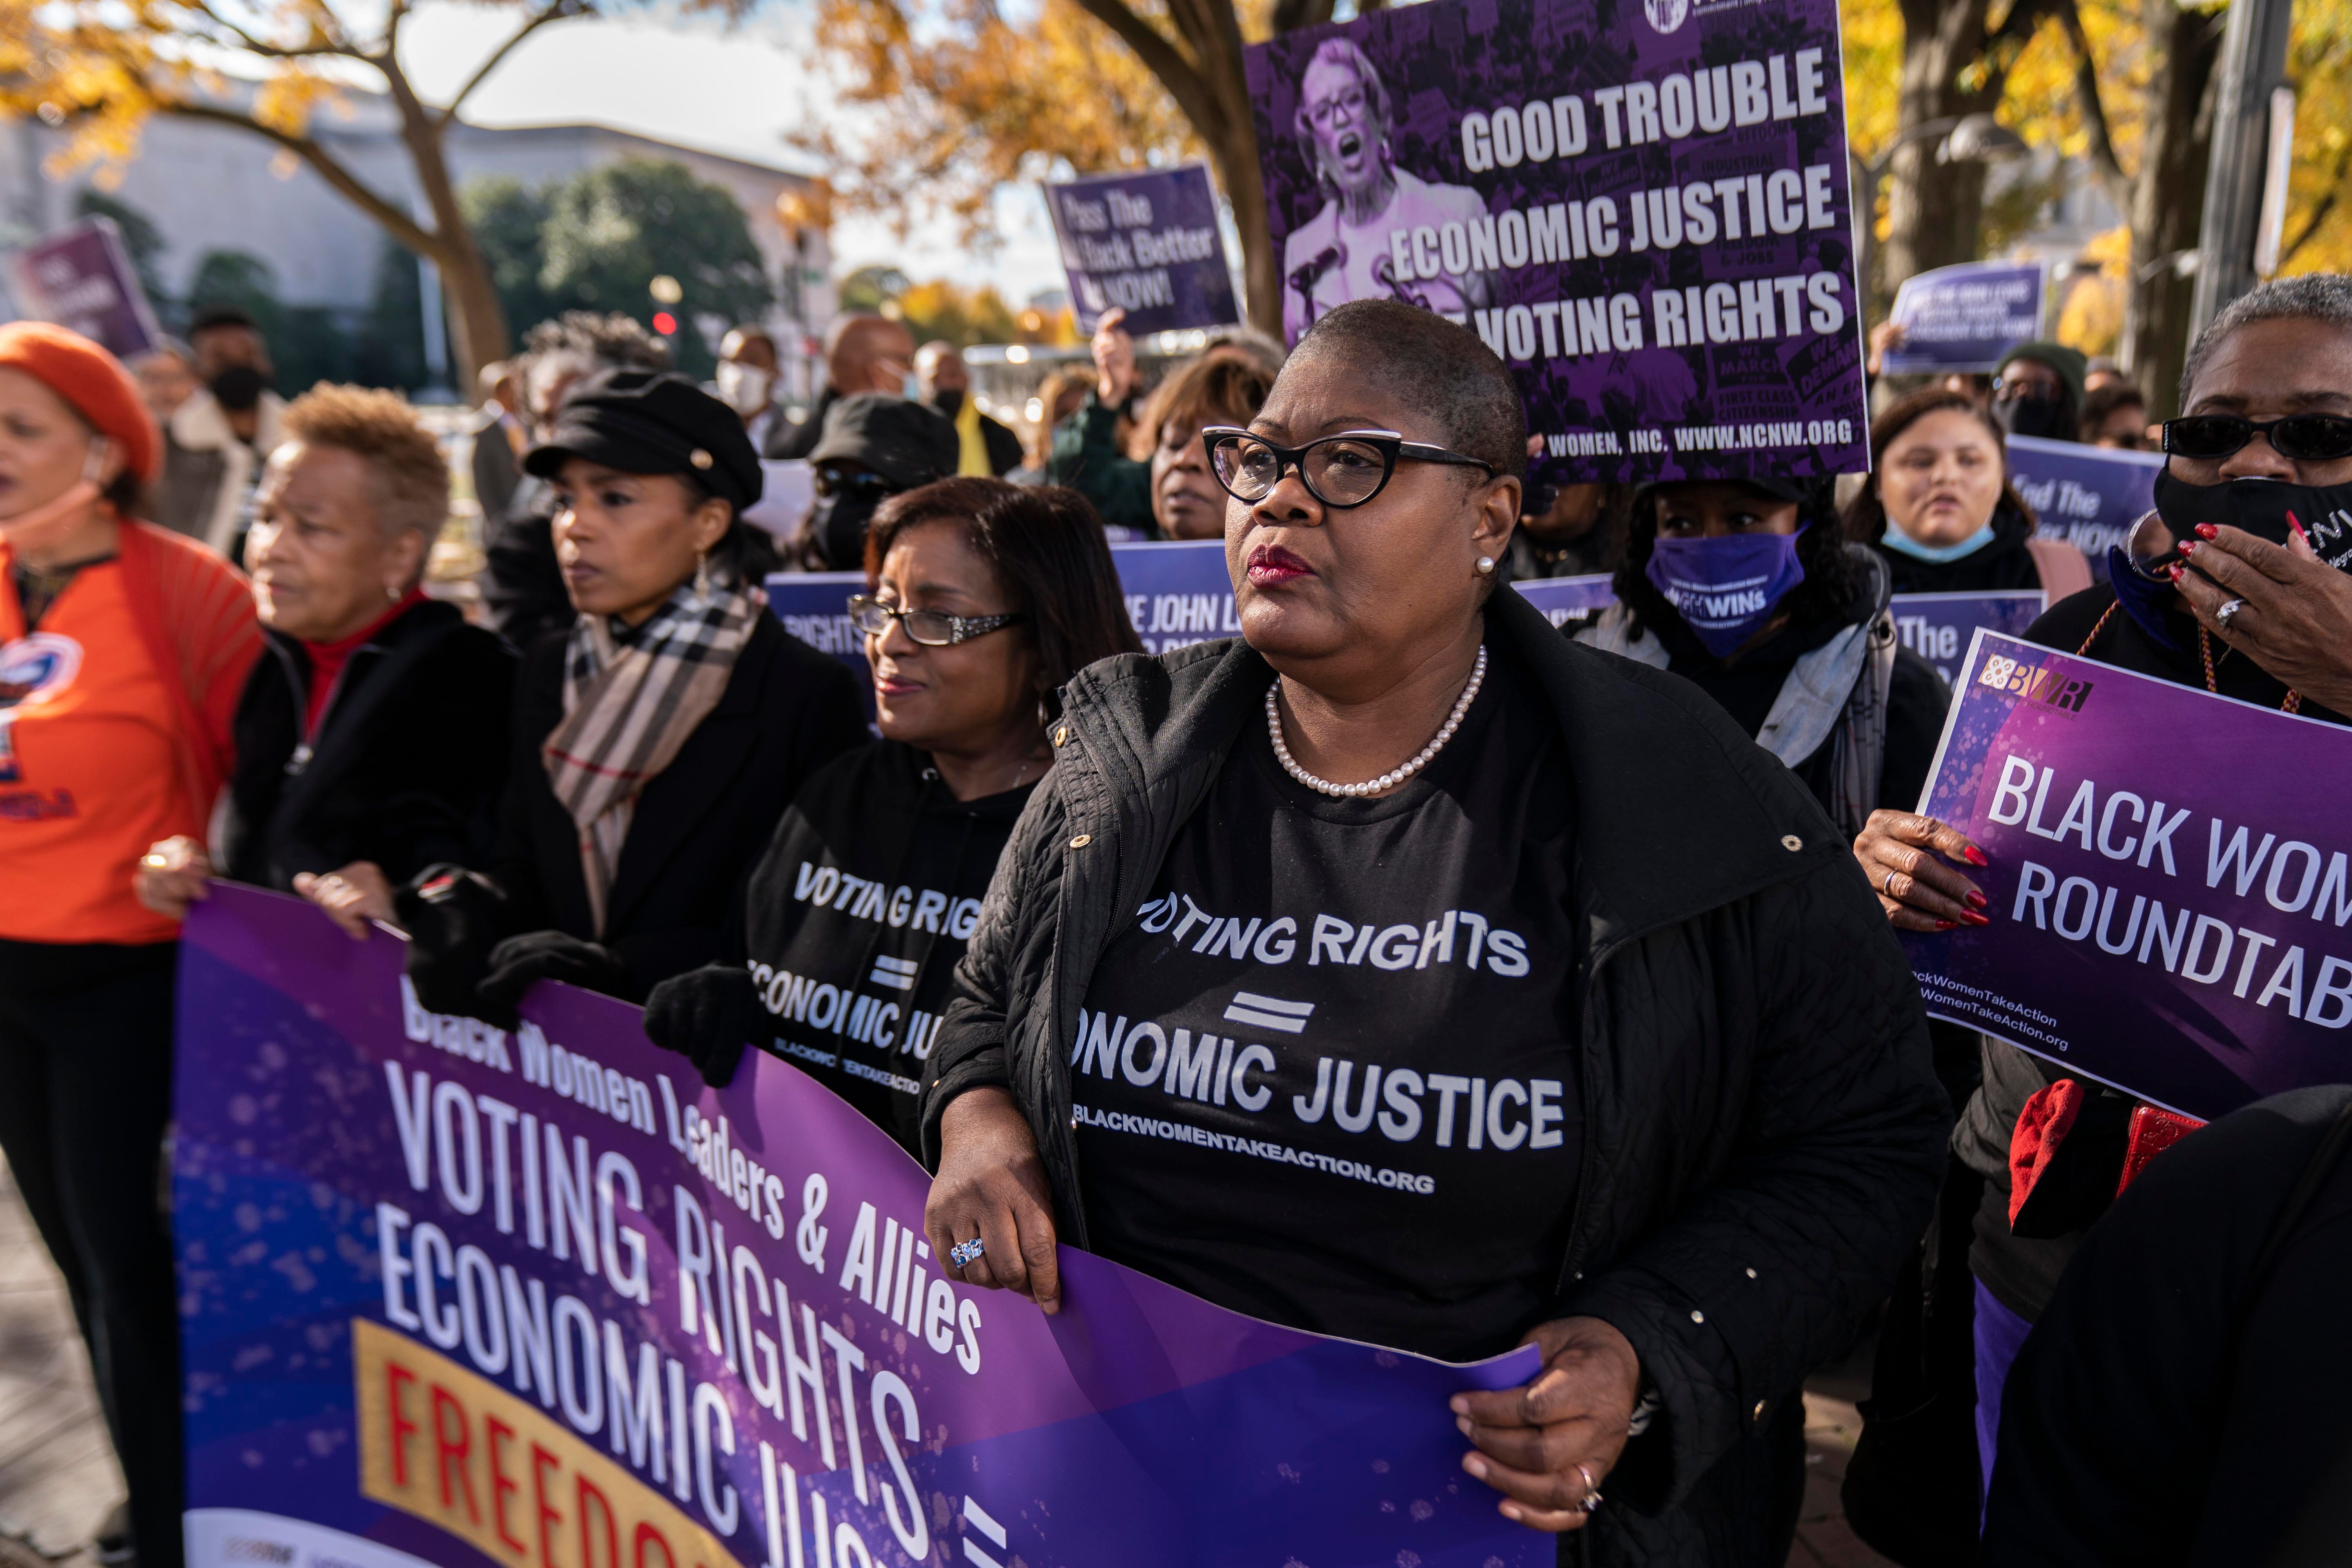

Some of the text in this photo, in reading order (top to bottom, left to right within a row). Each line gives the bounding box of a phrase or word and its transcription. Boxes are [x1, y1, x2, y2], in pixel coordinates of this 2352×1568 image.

[1461, 47, 1827, 173] GOOD TROUBLE
[1104, 189, 1153, 228] The
[1131, 225, 1214, 268] Better
[1390, 196, 1619, 282] ECONOMIC
[1630, 164, 1835, 252] JUSTICE
[1474, 292, 1644, 361] VOTING
[1653, 271, 1844, 348] RIGHTS
[1548, 431, 1623, 457] WOMEN,
[1629, 428, 1668, 453] INC.
[1674, 418, 1852, 451] WWW.NCNW.ORG
[2056, 480, 2101, 519] The
[1147, 592, 1219, 633] JOHN
[1896, 615, 1958, 660] The
[1988, 754, 2191, 877] BLACK
[793, 861, 913, 928] VOTING
[1308, 910, 1530, 977] RIGHTS
[2012, 860, 2352, 1029] ROUNDTAB
[747, 959, 900, 1049] CONOMIC
[1920, 987, 2069, 1052] WomenTakeAction.org
[1073, 1103, 1436, 1194] BLACKWOMENTAKEACTION.ORG
[1293, 1057, 1564, 1151] JUSTICE
[516, 1020, 657, 1136] Women
[655, 1073, 784, 1240] Leaders
[796, 1173, 829, 1274] &
[839, 1201, 981, 1375] Allies
[383, 1059, 650, 1307] VOTING
[674, 1184, 929, 1561] RIGHTS
[376, 1202, 885, 1568] ECONOMIC JU
[384, 1359, 708, 1568] FREED
